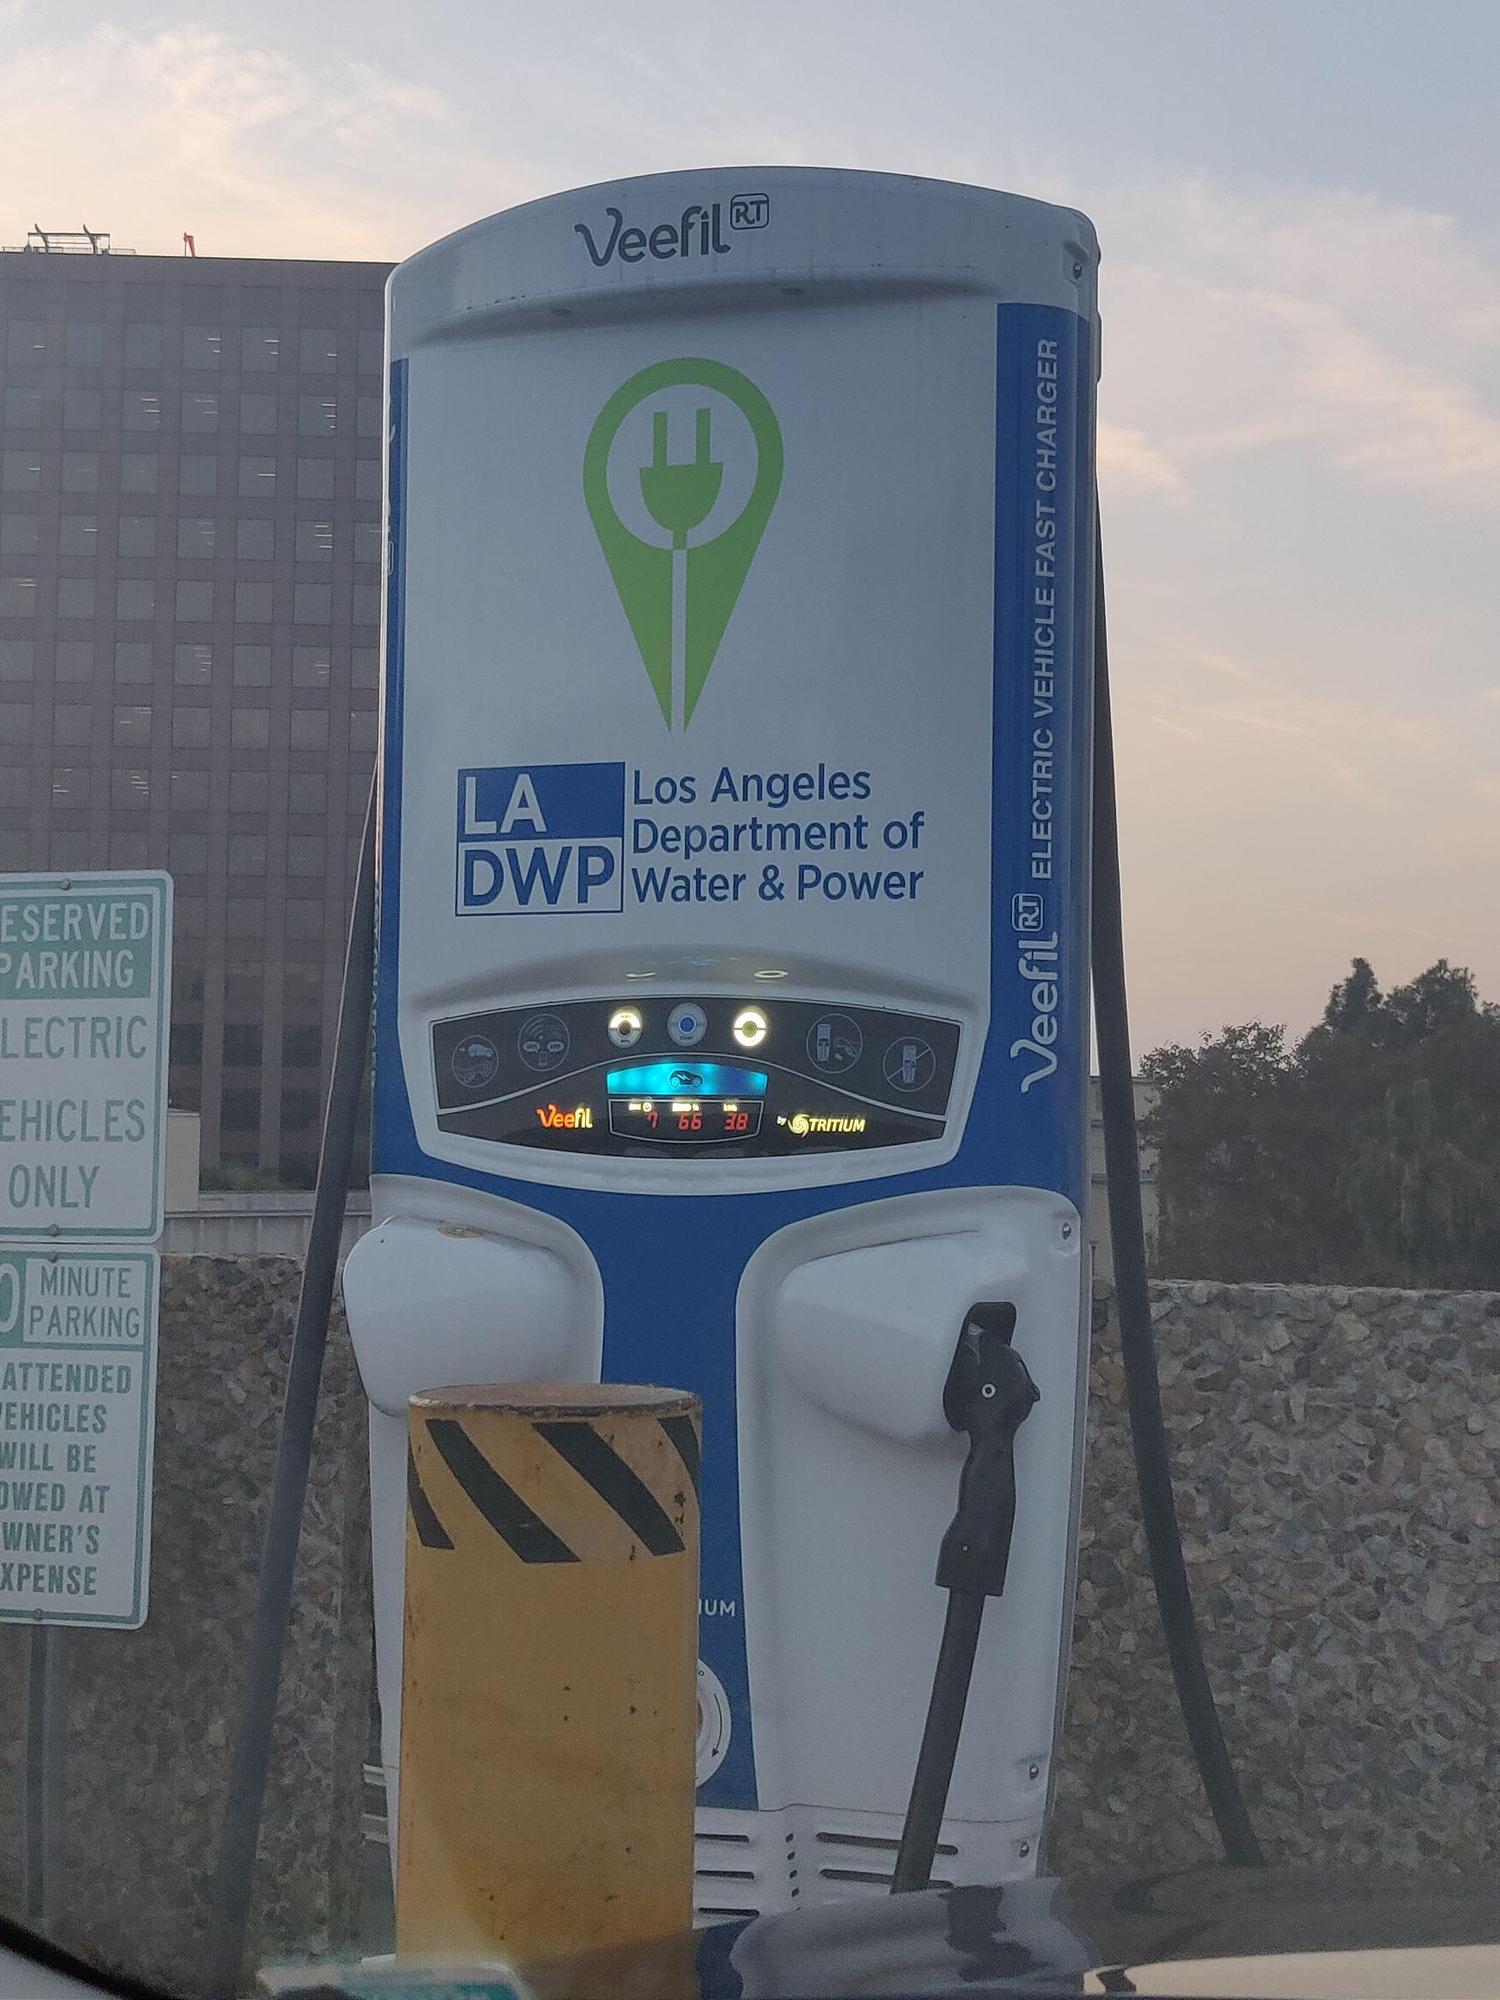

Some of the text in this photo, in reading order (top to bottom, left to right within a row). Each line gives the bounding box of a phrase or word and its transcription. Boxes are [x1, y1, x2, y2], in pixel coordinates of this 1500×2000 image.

[574, 199, 768, 267] Veefil RT
[1010, 338, 1058, 1093] Veefil RT ELECTRIC VEHICLE FAST CHARGER
[633, 763, 872, 808] Los Angeles
[464, 773, 547, 835] LA
[633, 811, 925, 860] Department of
[463, 845, 615, 907] DWP
[631, 863, 925, 903] Water & Power
[536, 1103, 594, 1129] Veefil
[678, 1112, 703, 1131] 66
[723, 1111, 750, 1131] 38
[808, 1117, 867, 1133] TRITIUM
[8, 1164, 100, 1209] ONLY
[40, 1265, 133, 1300] MINUTE
[29, 1305, 141, 1340] PARKING
[2, 1362, 133, 1395] ATTENDED
[0, 1401, 108, 1434] EHICLES
[0, 1442, 97, 1474] WILL BE
[78, 1484, 110, 1515] AT
